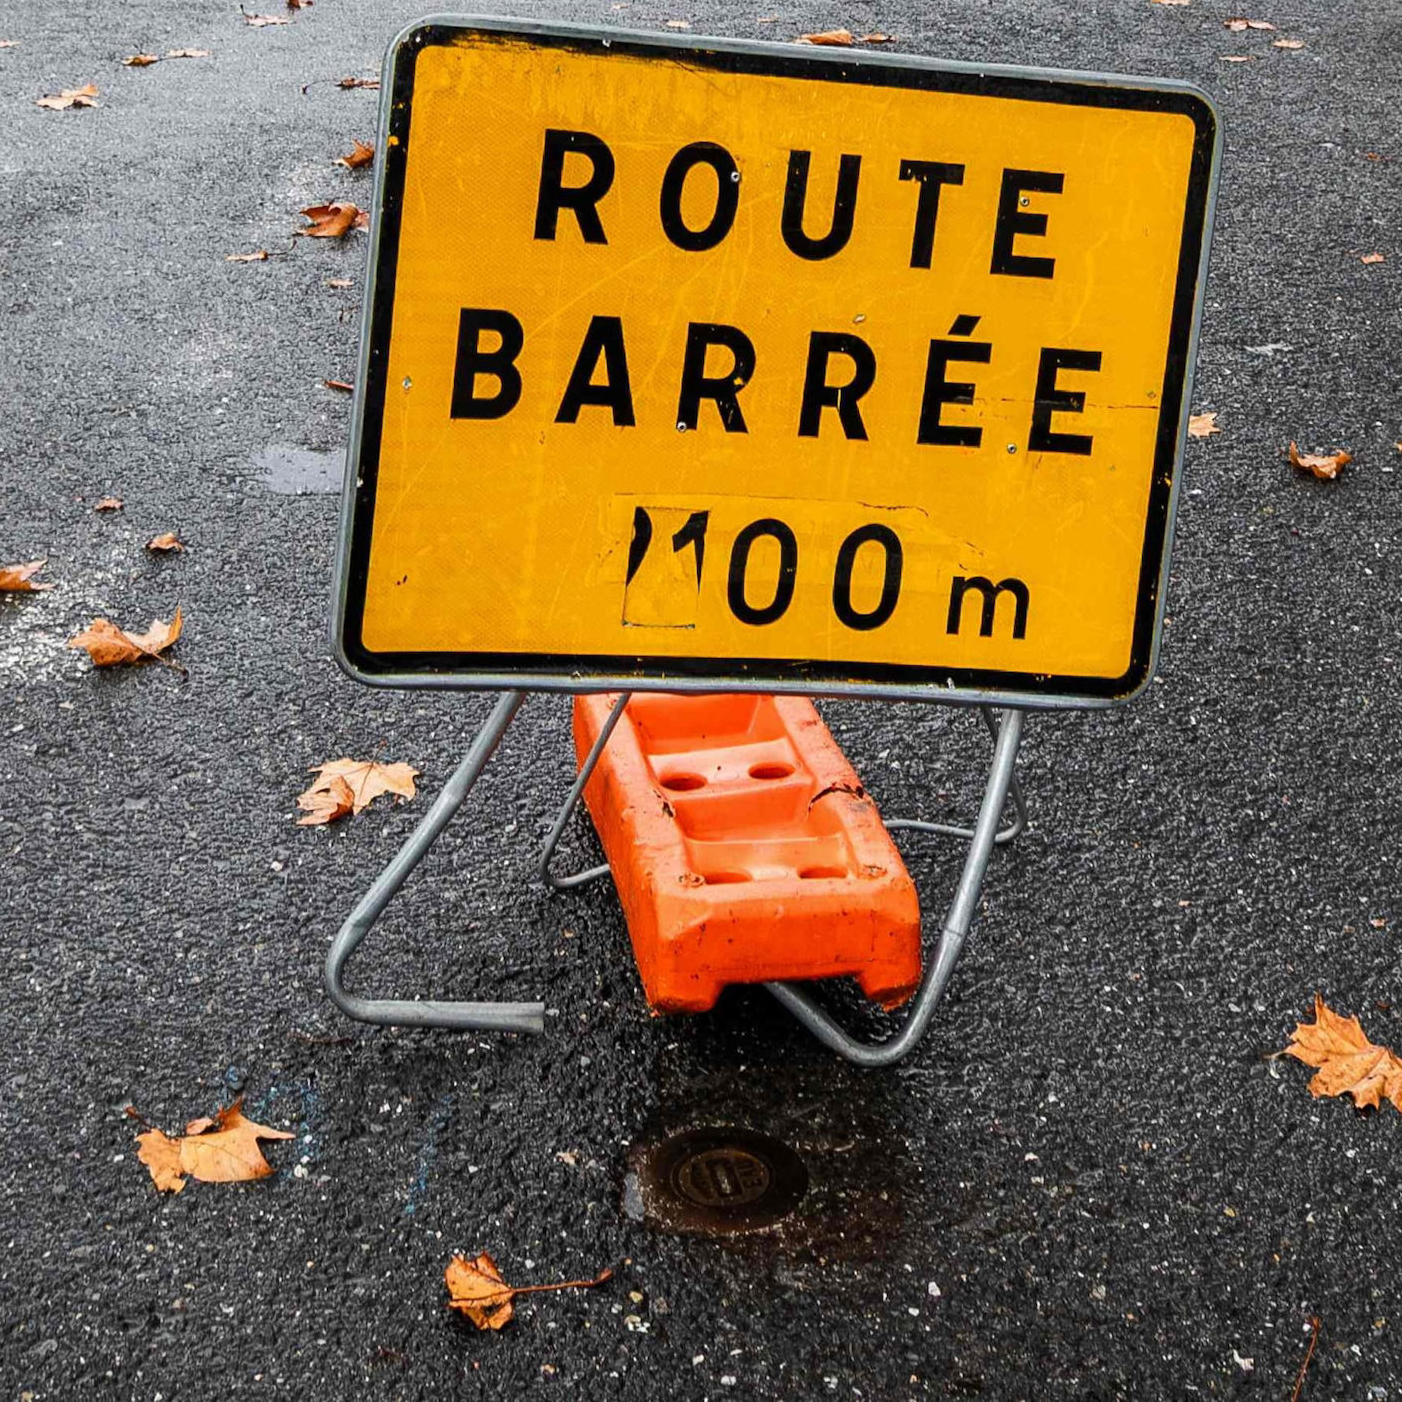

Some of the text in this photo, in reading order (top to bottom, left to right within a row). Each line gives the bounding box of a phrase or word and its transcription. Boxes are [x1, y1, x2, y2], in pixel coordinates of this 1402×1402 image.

[535, 129, 1065, 279] ROUTE
[450, 308, 1102, 456] BARRÉE
[946, 576, 1029, 639] m
